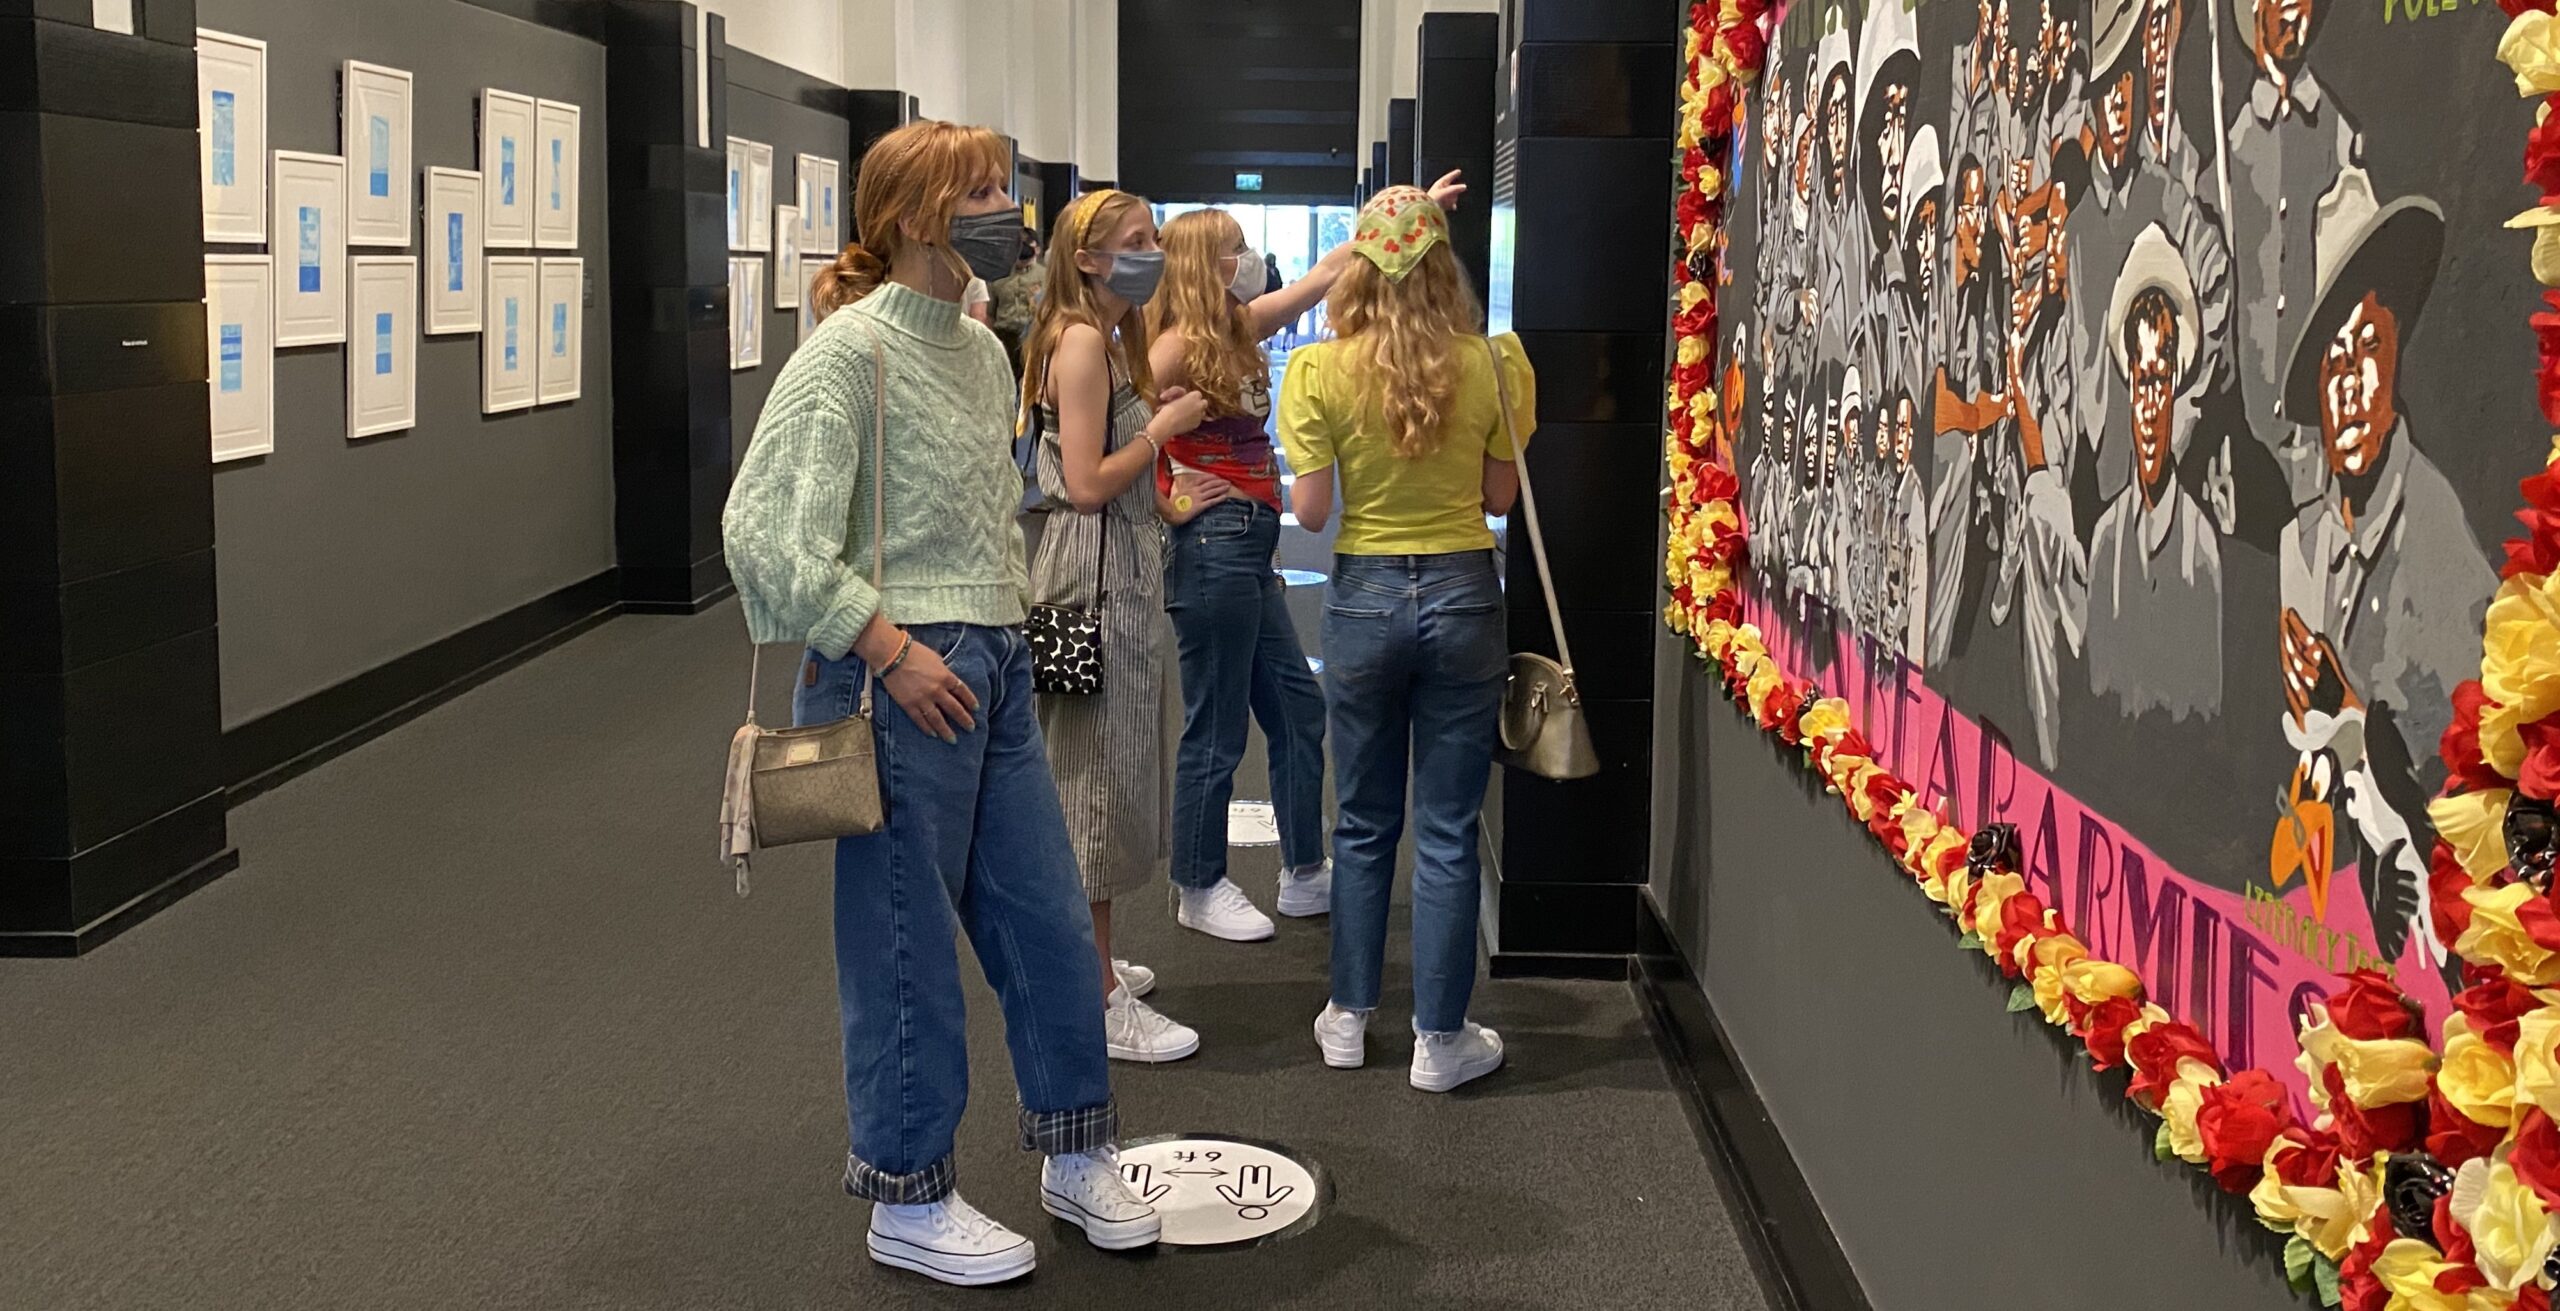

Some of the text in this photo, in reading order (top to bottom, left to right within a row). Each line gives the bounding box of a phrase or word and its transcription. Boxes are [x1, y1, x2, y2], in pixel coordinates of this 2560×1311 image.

[1860, 629, 2017, 834] BEAR
[1173, 1151, 1222, 1162] 6 ft
